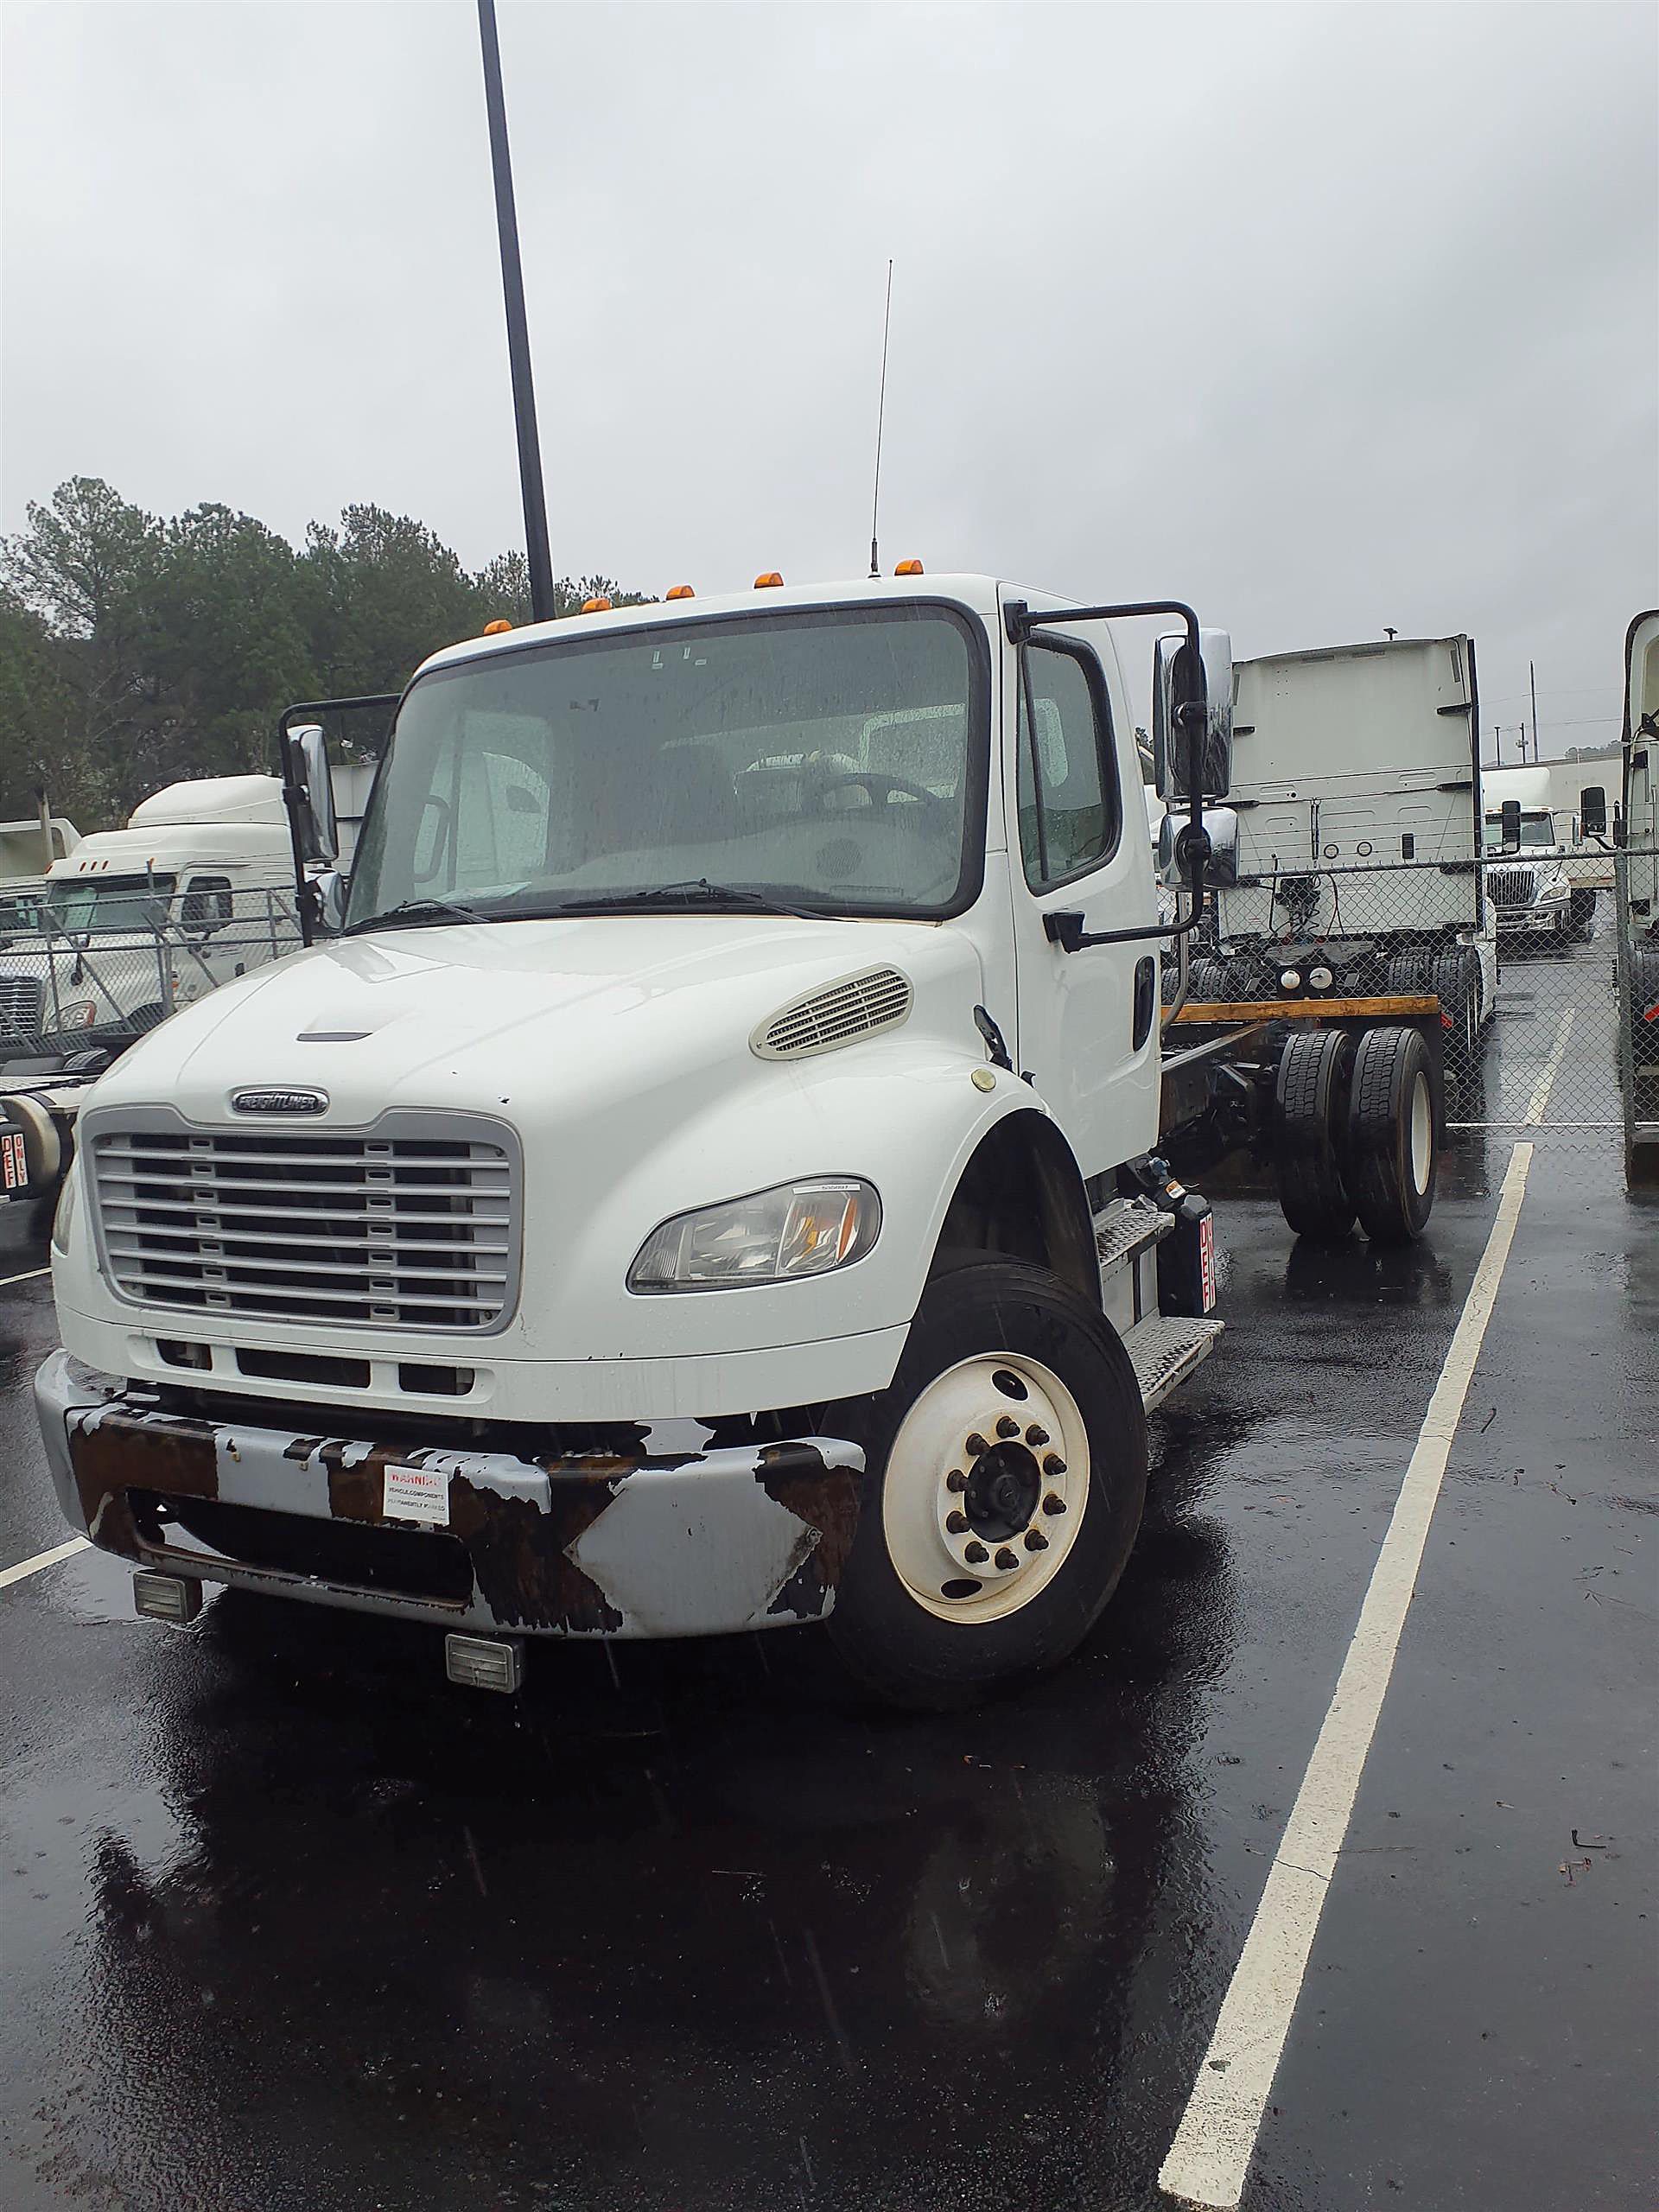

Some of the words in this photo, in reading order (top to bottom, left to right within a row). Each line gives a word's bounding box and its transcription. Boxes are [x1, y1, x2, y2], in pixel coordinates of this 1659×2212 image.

[239, 1092, 315, 1109] FREIGHTLINER
[3, 1138, 14, 1185] DEF
[16, 1135, 26, 1183] ONLY
[388, 1498, 423, 1508] PEANENTLY
[423, 1503, 445, 1511] MED
